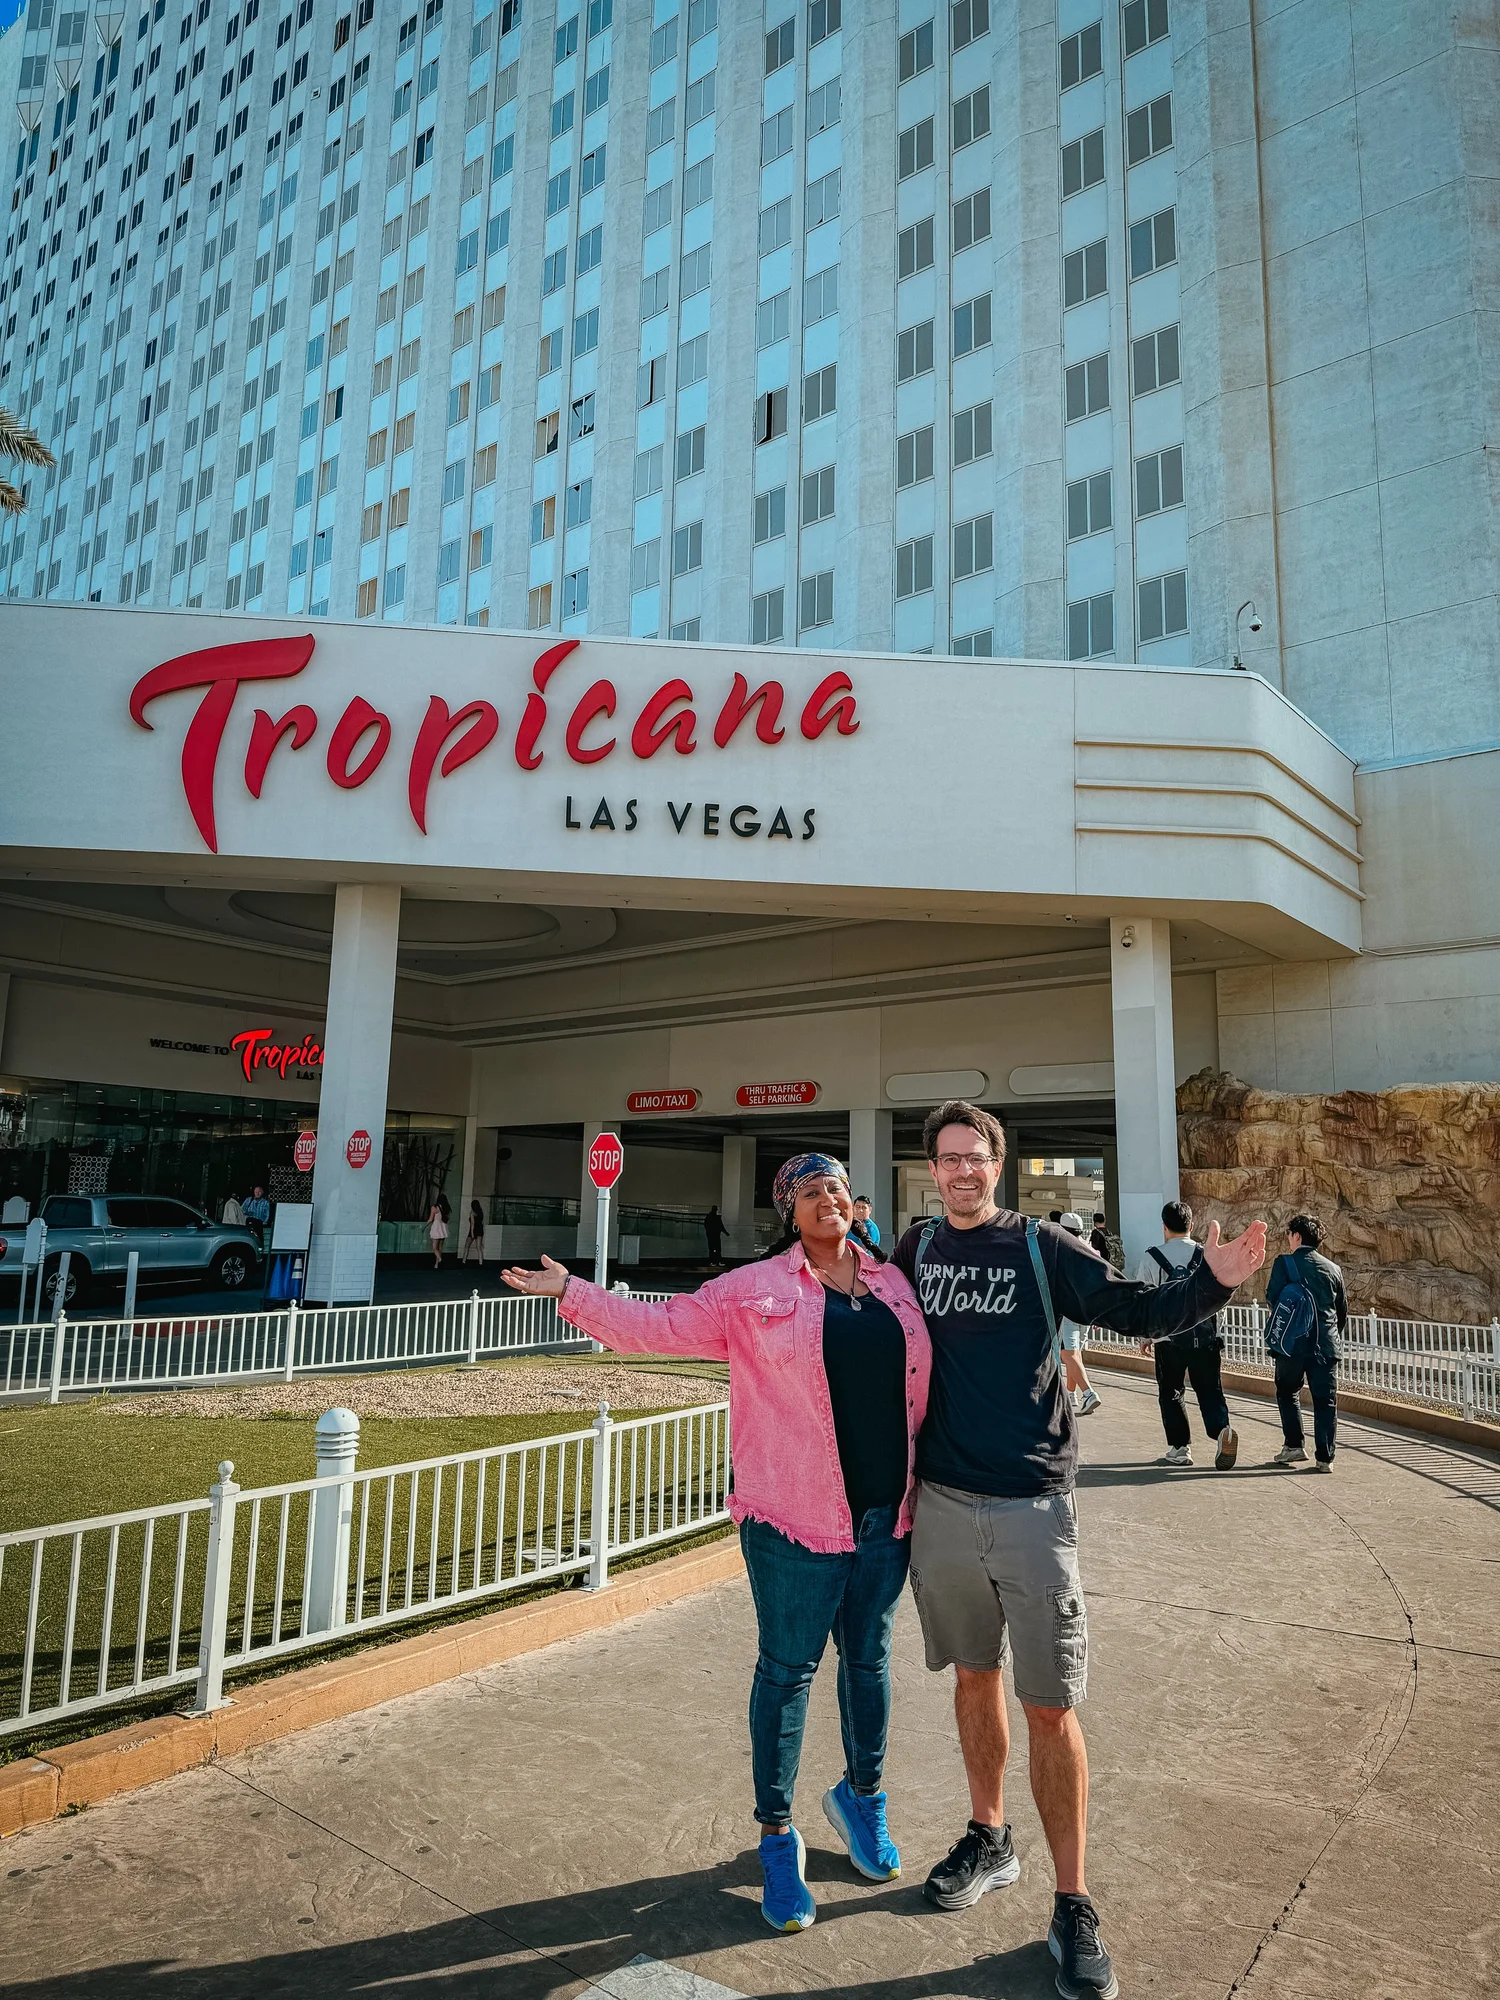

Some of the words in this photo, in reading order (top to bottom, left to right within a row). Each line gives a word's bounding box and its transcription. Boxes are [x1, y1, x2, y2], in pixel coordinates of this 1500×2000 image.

[129, 633, 861, 854] Tropicana
[565, 795, 638, 832] LAS
[667, 800, 817, 841] VEGAS
[149, 1038, 210, 1054] WELCOME
[213, 1045, 230, 1056] TO
[296, 1070, 315, 1081] LAS
[744, 1086, 766, 1095] THRU
[767, 1084, 799, 1094] TRAFFIC
[801, 1083, 807, 1092] &
[635, 1094, 688, 1108] LIMO/TAXI
[748, 1095, 766, 1105] SELF
[767, 1093, 802, 1104] PARKING
[297, 1139, 316, 1154] STOP
[349, 1137, 371, 1152] STOP
[590, 1149, 620, 1171] STOP
[919, 1263, 955, 1280] TURN
[960, 1265, 981, 1281] IT
[987, 1267, 1016, 1283] UP
[919, 1271, 1018, 1317] World
